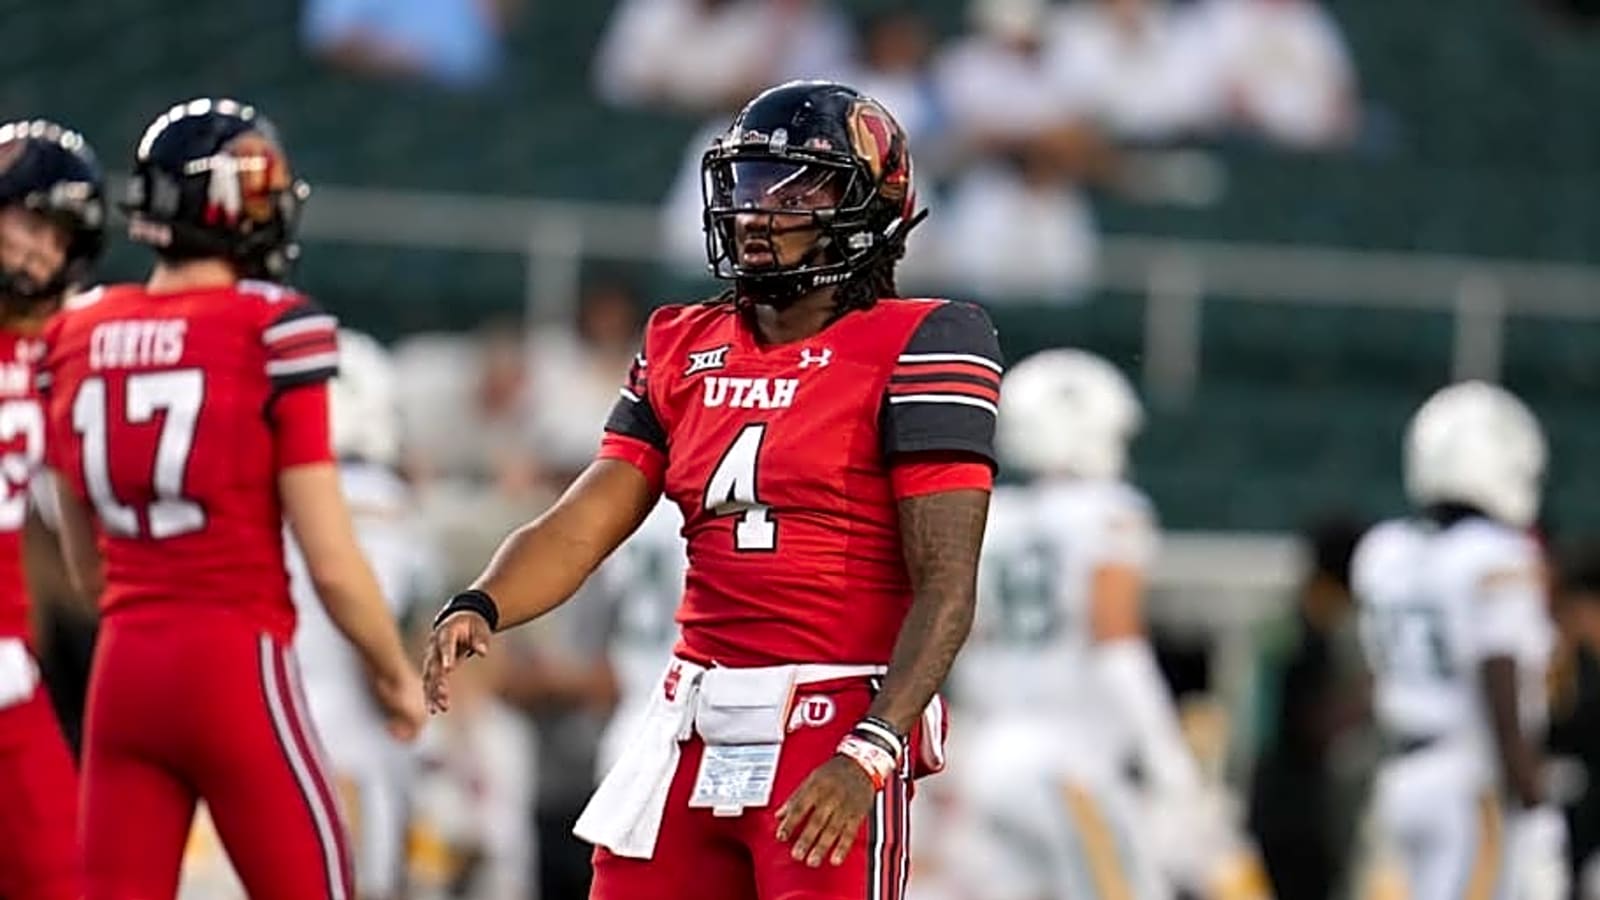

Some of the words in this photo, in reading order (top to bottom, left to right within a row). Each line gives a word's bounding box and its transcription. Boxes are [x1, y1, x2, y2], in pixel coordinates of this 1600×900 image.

[90, 319, 187, 370] CURTIS
[703, 376, 799, 409] UTAH
[71, 367, 207, 540] 17
[704, 423, 777, 552] 4
